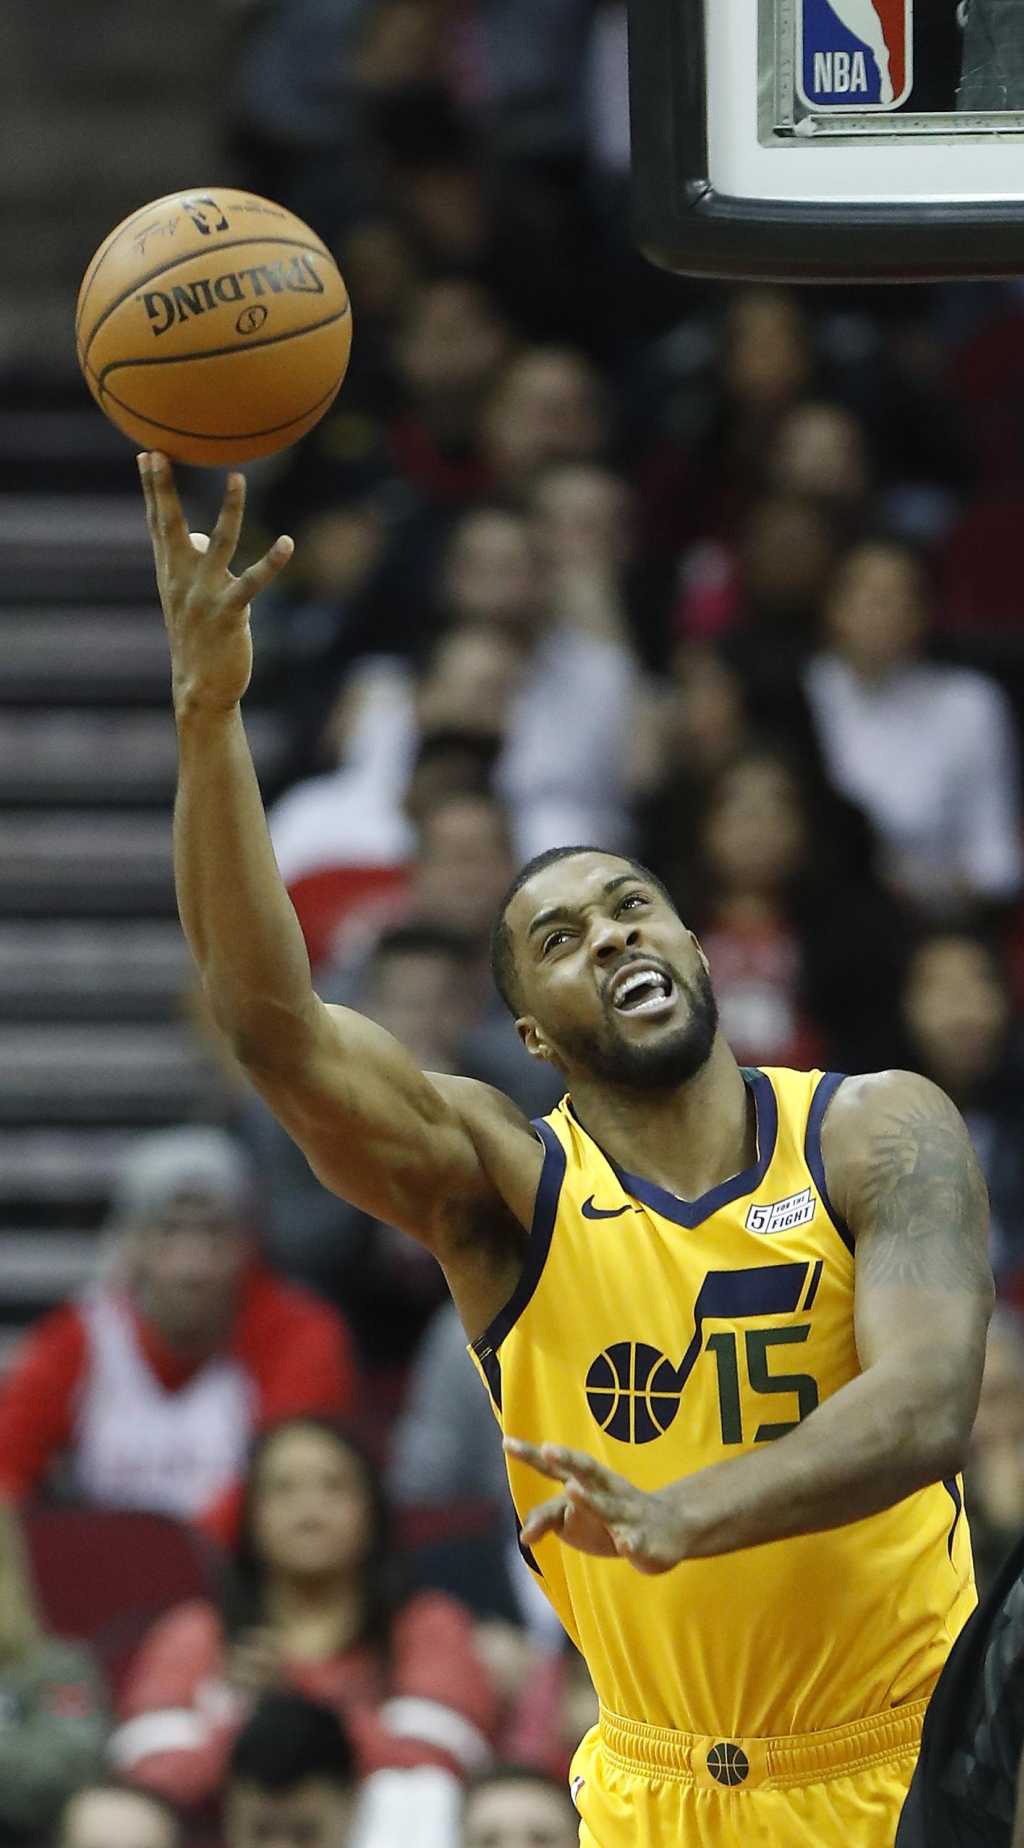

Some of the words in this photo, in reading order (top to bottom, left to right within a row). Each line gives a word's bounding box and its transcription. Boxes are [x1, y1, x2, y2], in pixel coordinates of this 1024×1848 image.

[814, 51, 868, 93] NBA
[143, 253, 324, 337] SPALDING
[751, 1209, 768, 1230] 5
[771, 1206, 810, 1230] FIGHT
[704, 1323, 820, 1445] 15
